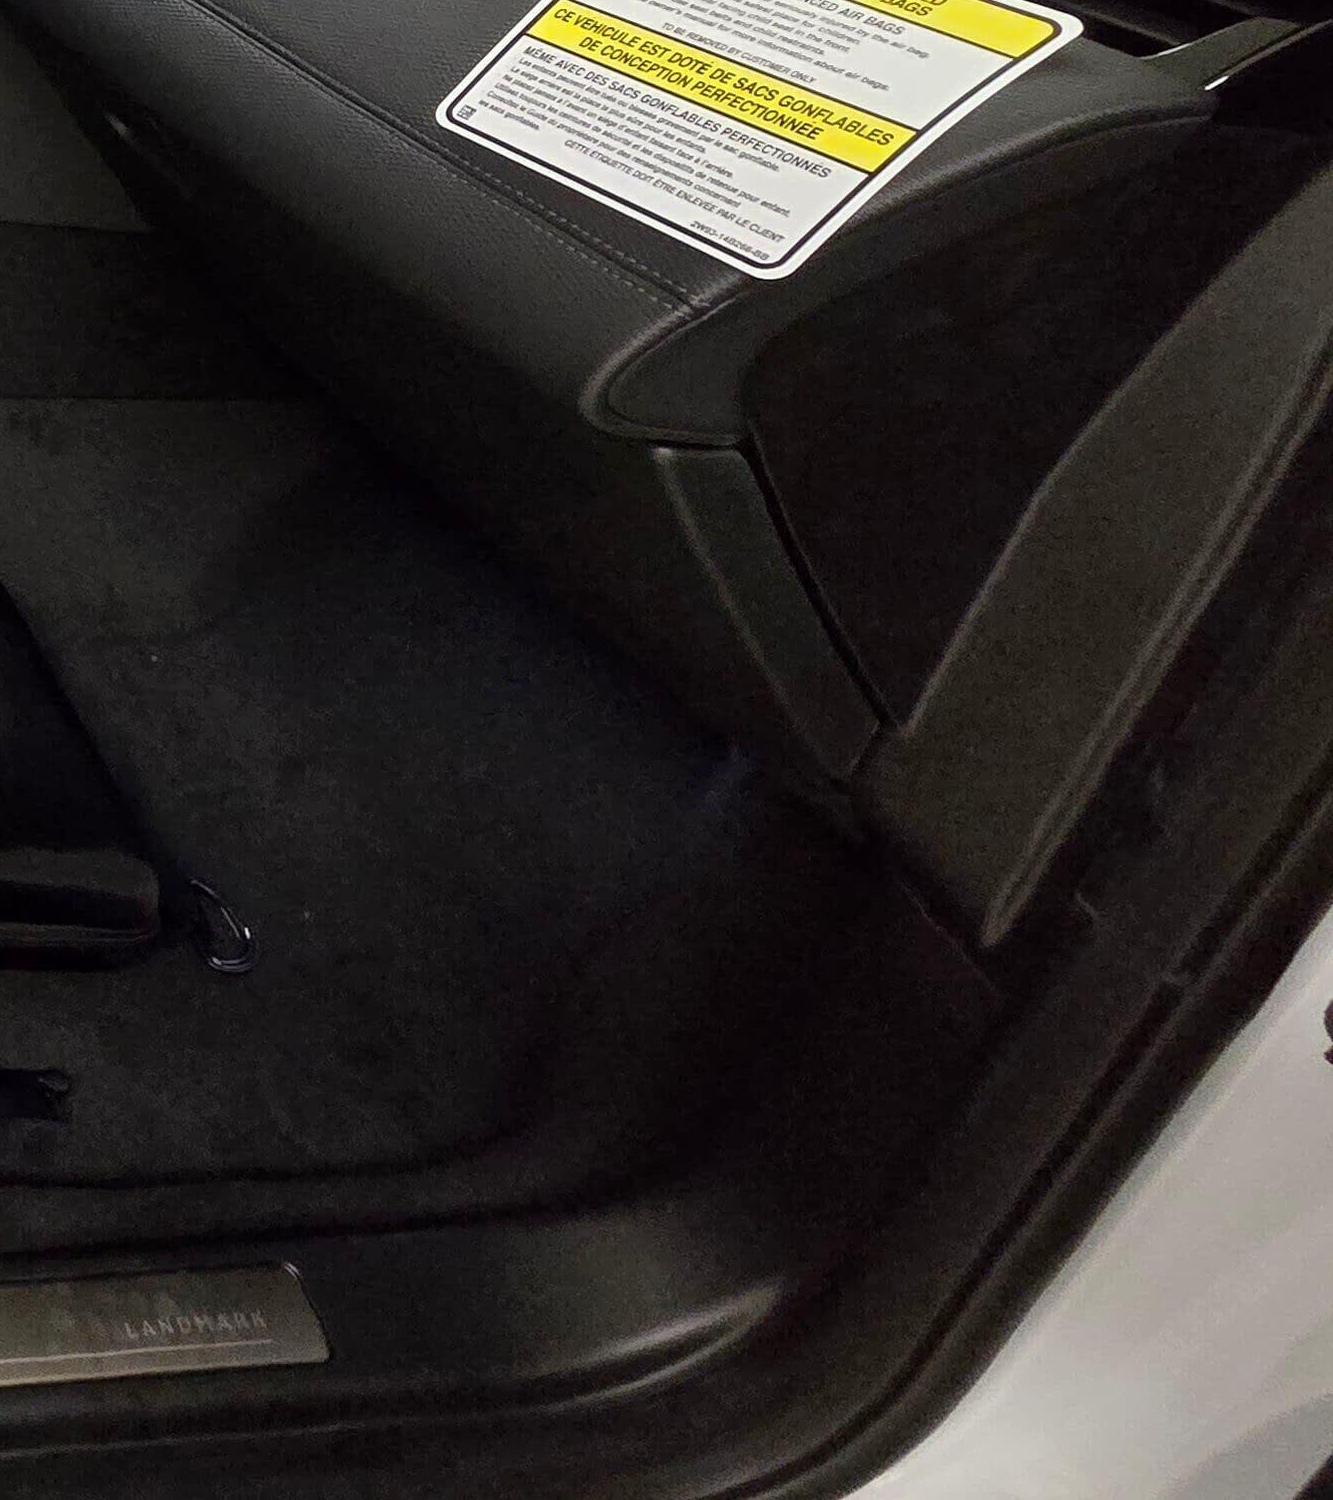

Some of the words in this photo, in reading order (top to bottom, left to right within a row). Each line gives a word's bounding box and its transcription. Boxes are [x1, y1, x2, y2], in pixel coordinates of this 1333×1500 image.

[660, 22, 676, 31] TO
[672, 26, 687, 35] BE
[685, 31, 729, 51] REMOVED
[726, 46, 743, 56] BY
[738, 51, 792, 74] CUSTOMER
[789, 70, 818, 84] ONLY
[836, 6, 865, 21] AIR
[862, 15, 907, 35] BAGS
[552, 7, 576, 22] CE
[636, 40, 672, 59] EST
[665, 49, 715, 75] DOTÉ
[707, 67, 737, 84] DE
[730, 76, 781, 101] SACS
[774, 93, 897, 146] GONFLABLES
[553, 58, 587, 76] AVEC
[583, 71, 610, 86] DES
[606, 80, 642, 99] SACS
[637, 93, 723, 133] GONFLABLES
[577, 36, 604, 52] DE
[597, 44, 694, 87] CONCEPTION
[688, 77, 829, 140] PERFECTIONNÉE
[562, 138, 591, 154] CETTE
[630, 169, 655, 183] DOIT
[714, 207, 738, 221] PAR
[733, 216, 752, 227] LE
[746, 222, 786, 243] CLIENT
[124, 1309, 268, 1340] LANDMARK
